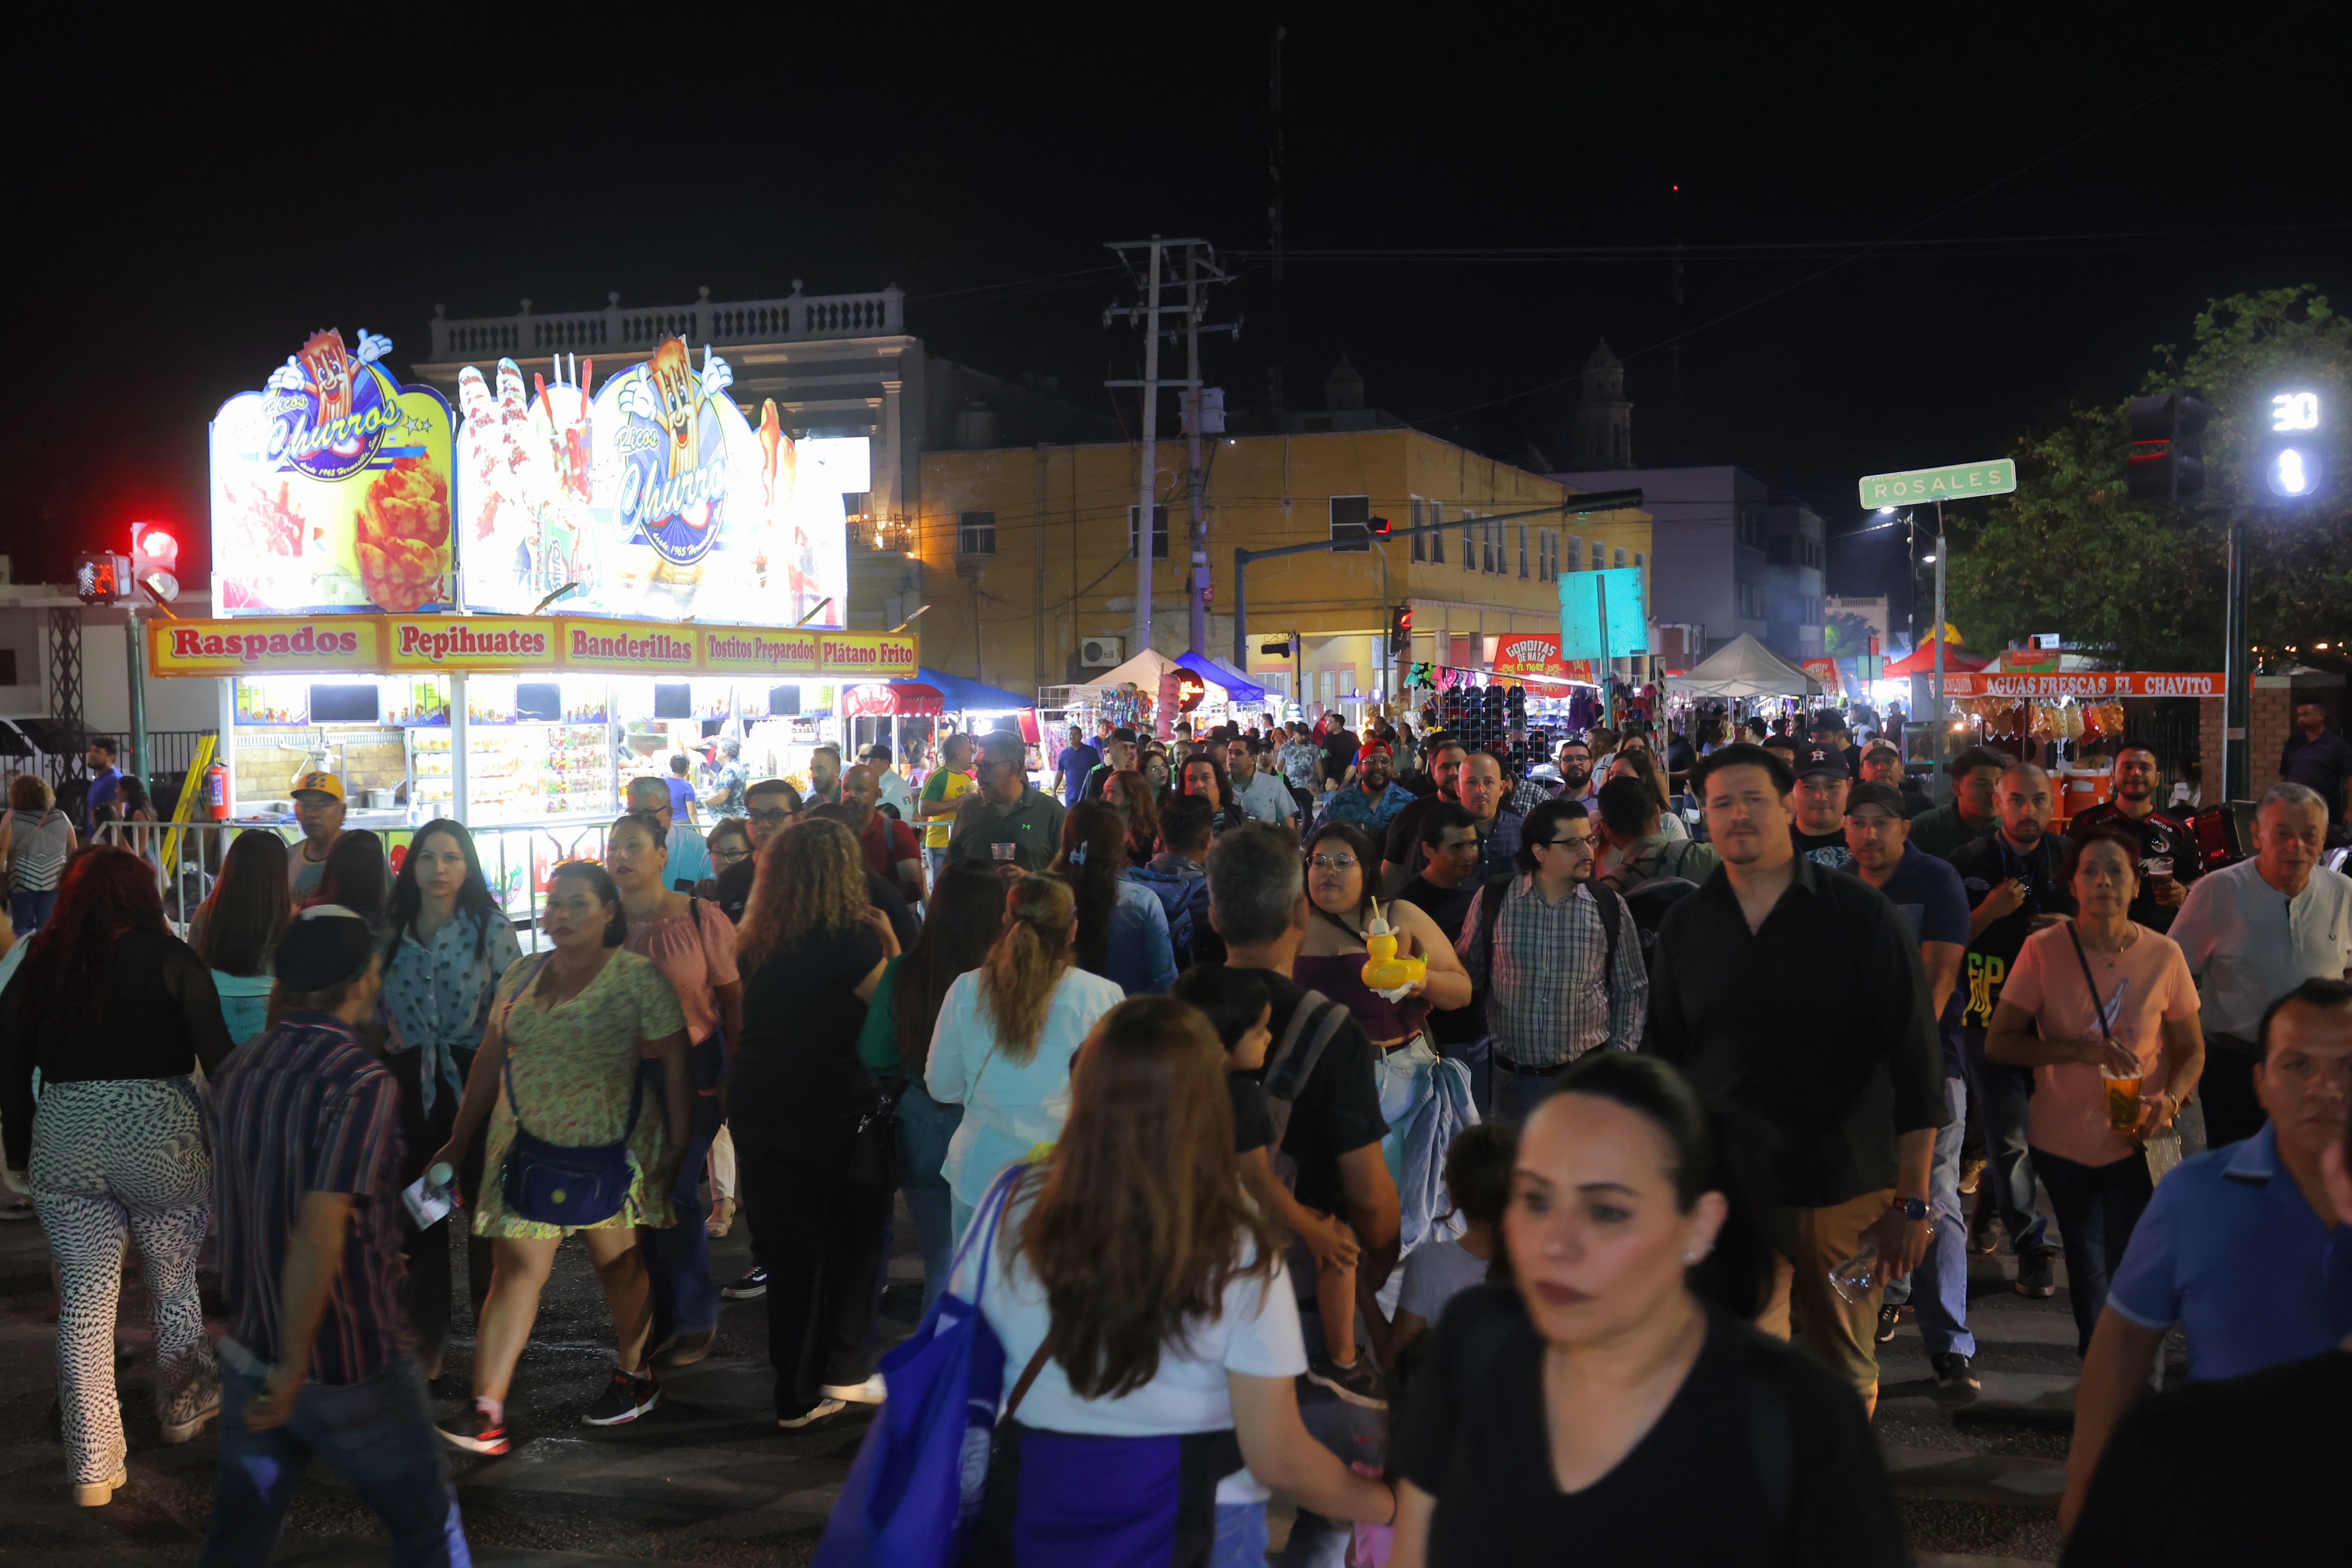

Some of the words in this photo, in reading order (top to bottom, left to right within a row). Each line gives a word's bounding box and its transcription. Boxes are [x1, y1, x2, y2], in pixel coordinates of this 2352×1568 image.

[264, 394, 307, 418] Ricos
[2273, 393, 2318, 431] 30
[260, 400, 401, 471] Churros
[614, 426, 658, 461] Ricos
[613, 453, 739, 543] Churros
[1875, 470, 2001, 499] ROSALES
[174, 626, 357, 660] Raspados
[401, 627, 545, 659] Pepihuates
[572, 629, 691, 660] Banderillas
[707, 634, 752, 659] Tostitos
[754, 636, 814, 664] Preparados
[822, 641, 876, 665] Plátano
[879, 643, 913, 664] Frito
[1505, 640, 1557, 658] GORDITAS
[1517, 653, 1526, 663] DE
[1527, 651, 1546, 663] NATA
[1517, 663, 1524, 671] EL
[1526, 662, 1545, 672] TIGRE
[1986, 677, 2036, 695] AGUAS
[2038, 677, 2107, 695] FRESCAS
[2114, 677, 2133, 694] EL
[2144, 677, 2211, 694] CHAVITO
[1812, 751, 1824, 761] H
[2150, 818, 2167, 829] ARCO
